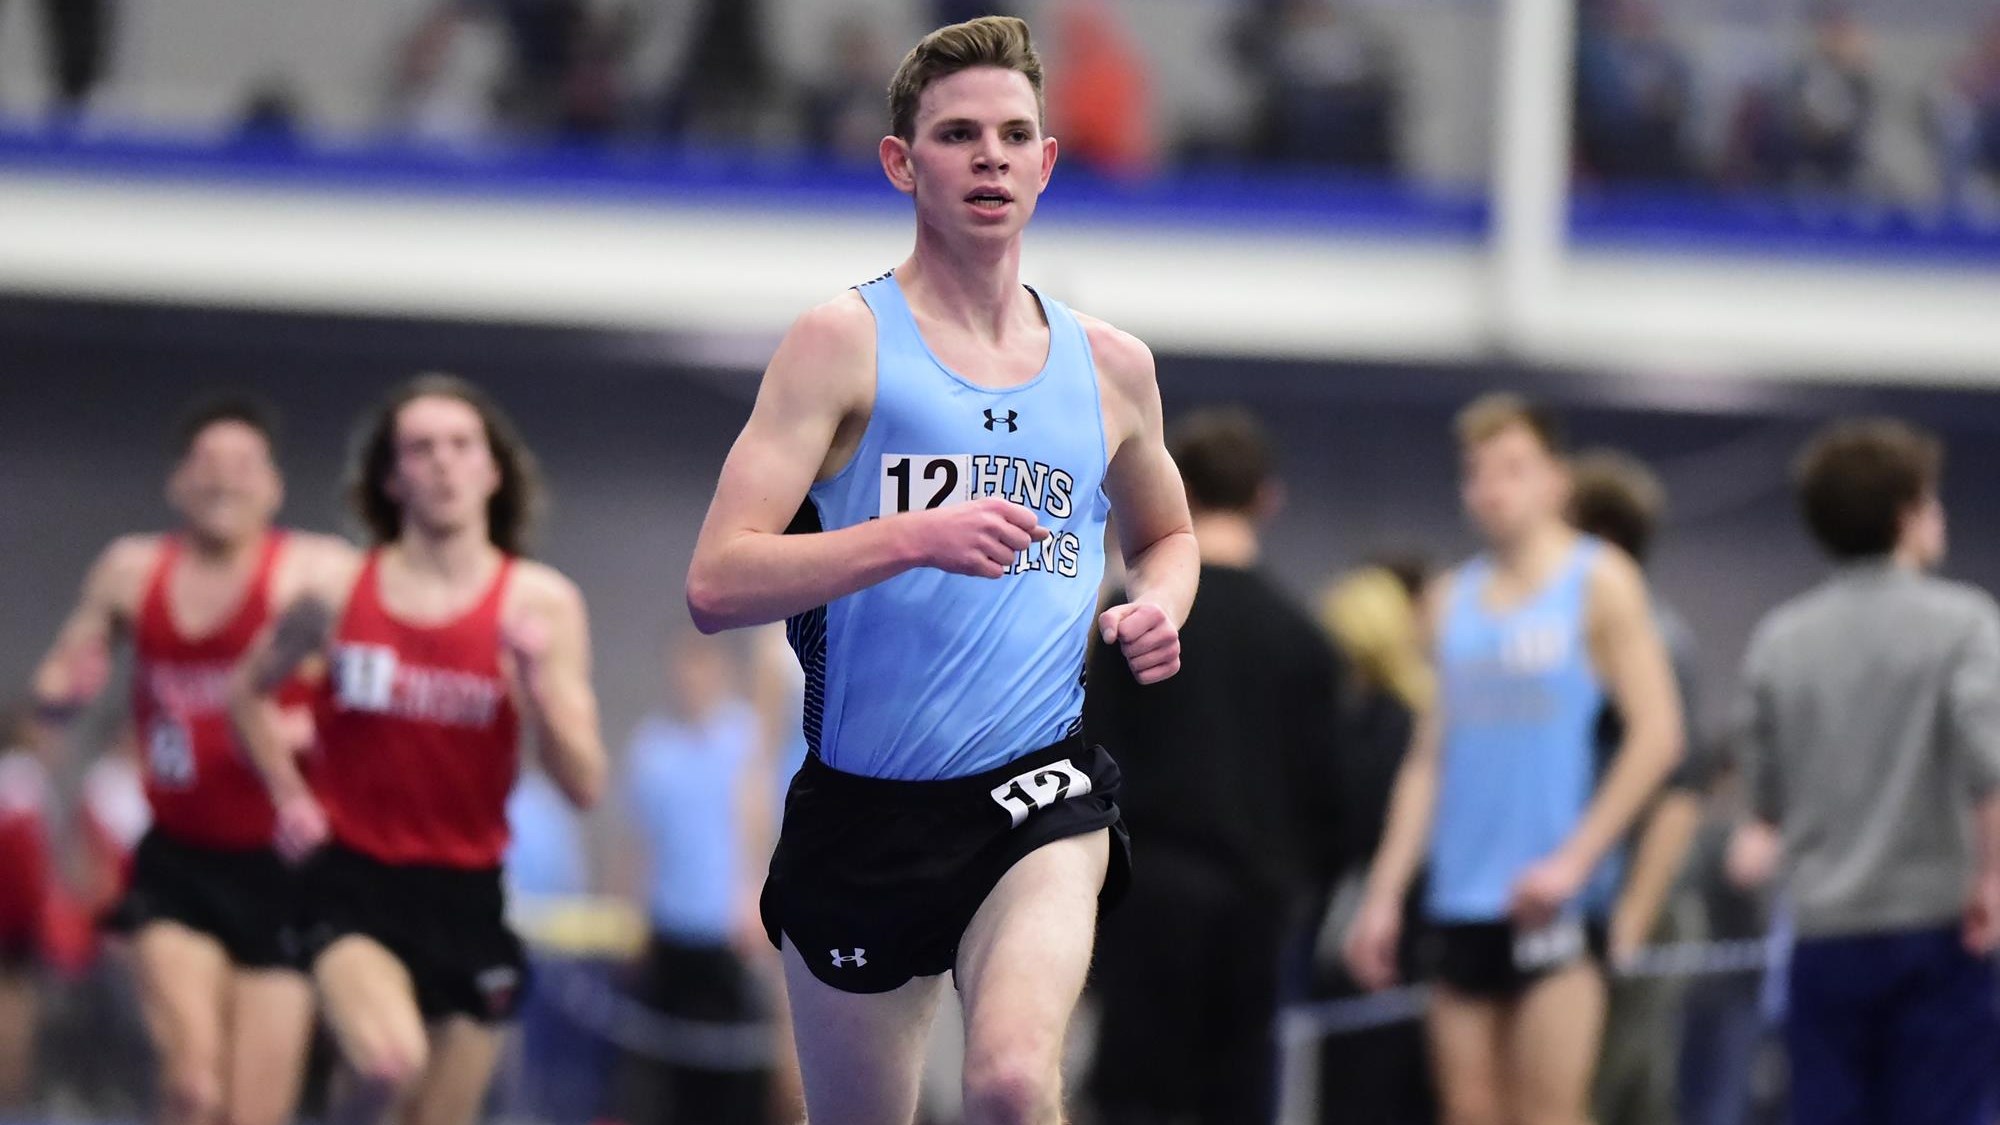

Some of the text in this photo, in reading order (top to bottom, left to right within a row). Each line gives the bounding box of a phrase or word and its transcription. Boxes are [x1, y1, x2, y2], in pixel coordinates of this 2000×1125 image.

[887, 458, 959, 514] 12
[1003, 530, 1080, 578] INS
[1002, 770, 1071, 816] 12
